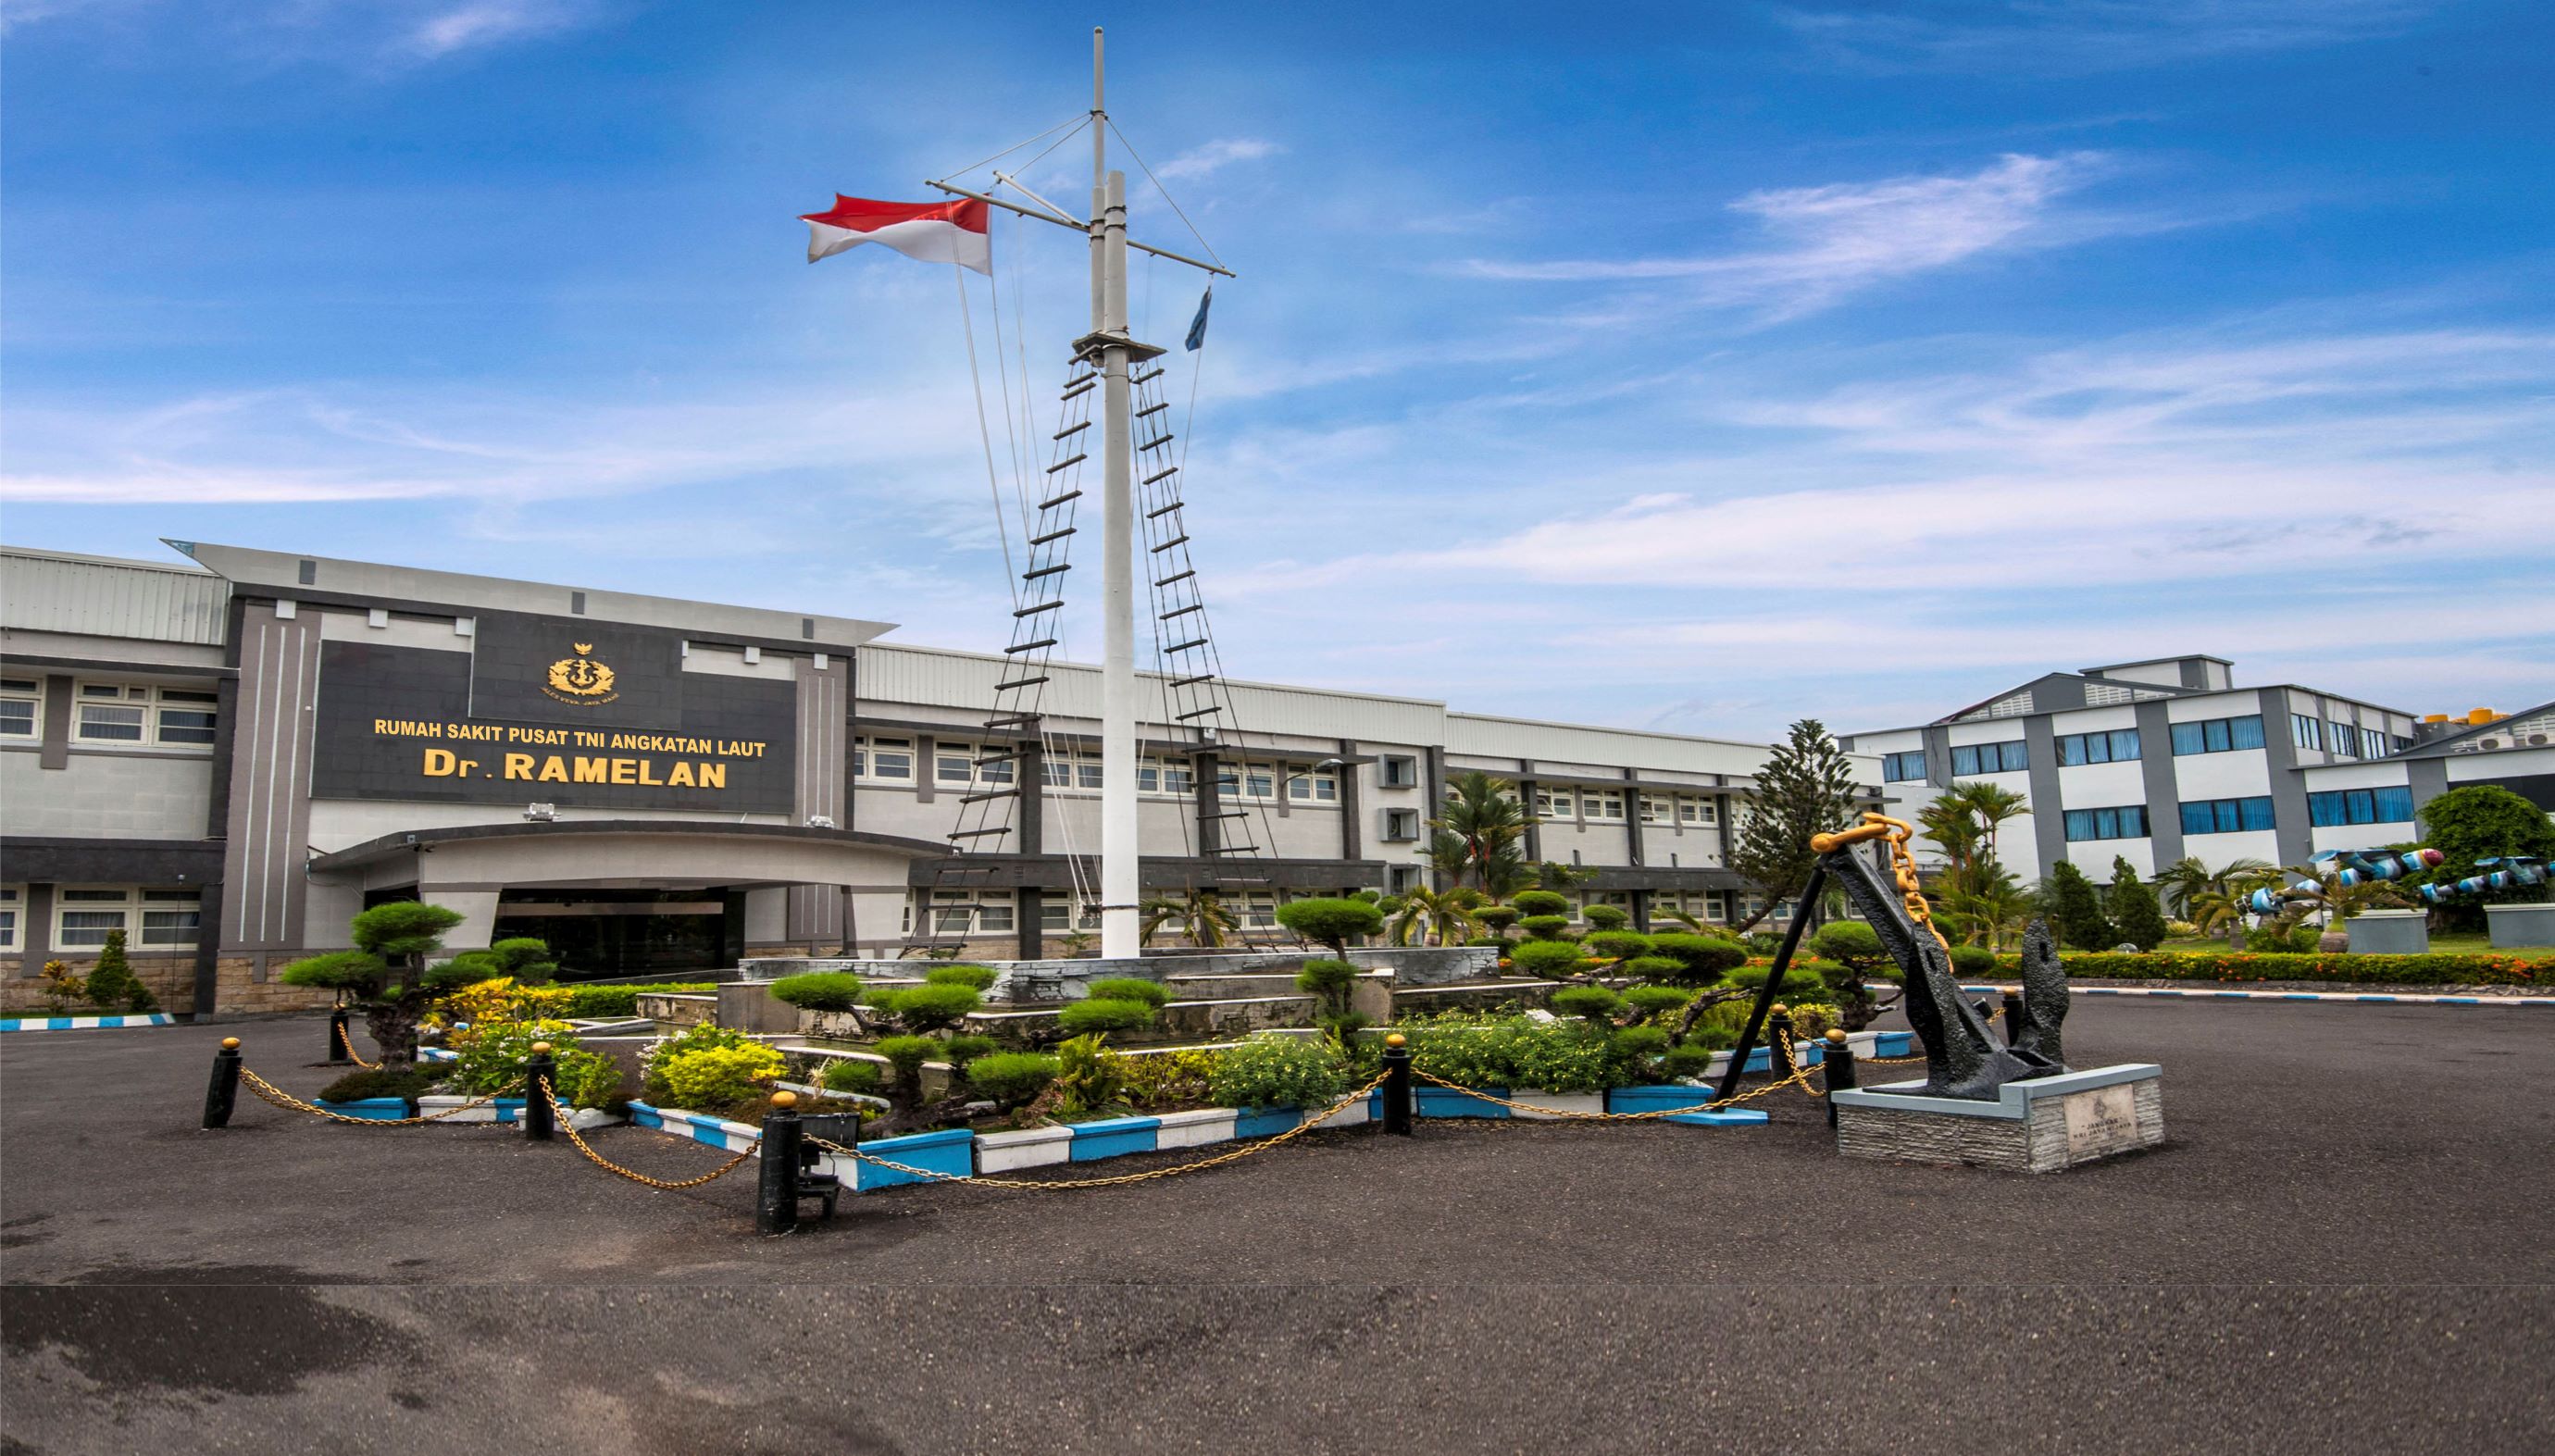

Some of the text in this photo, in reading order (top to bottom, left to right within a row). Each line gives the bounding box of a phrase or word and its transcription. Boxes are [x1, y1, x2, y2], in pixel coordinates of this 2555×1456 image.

[374, 718, 766, 757] RUMAH SAKIT PUSAT TNI ANGKATAN LAUT
[504, 753, 727, 789] RAMELAN
